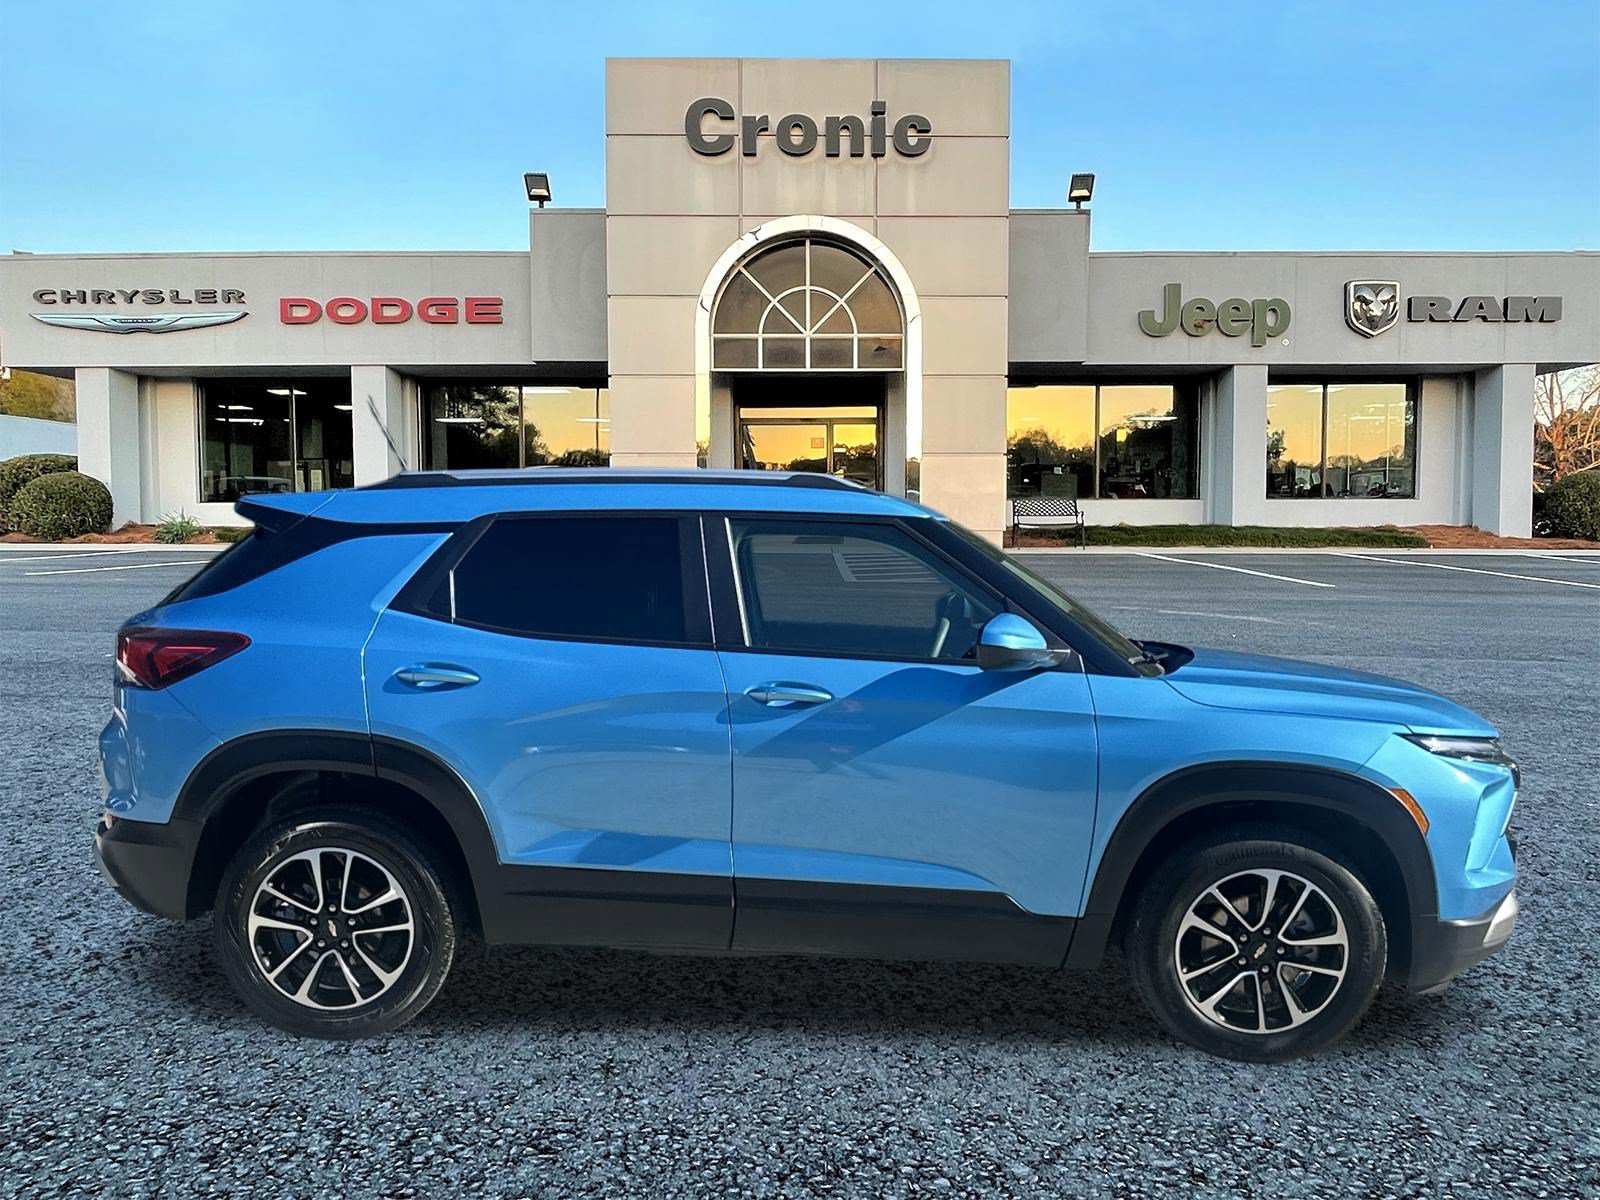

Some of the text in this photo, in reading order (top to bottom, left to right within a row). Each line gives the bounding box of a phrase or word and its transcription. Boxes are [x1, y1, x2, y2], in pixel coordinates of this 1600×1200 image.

[685, 97, 932, 158] Cronic
[32, 288, 246, 305] CHRYSLER
[279, 296, 504, 325] DODGE
[1407, 296, 1563, 323] RAM
[1138, 283, 1291, 347] Jeep
